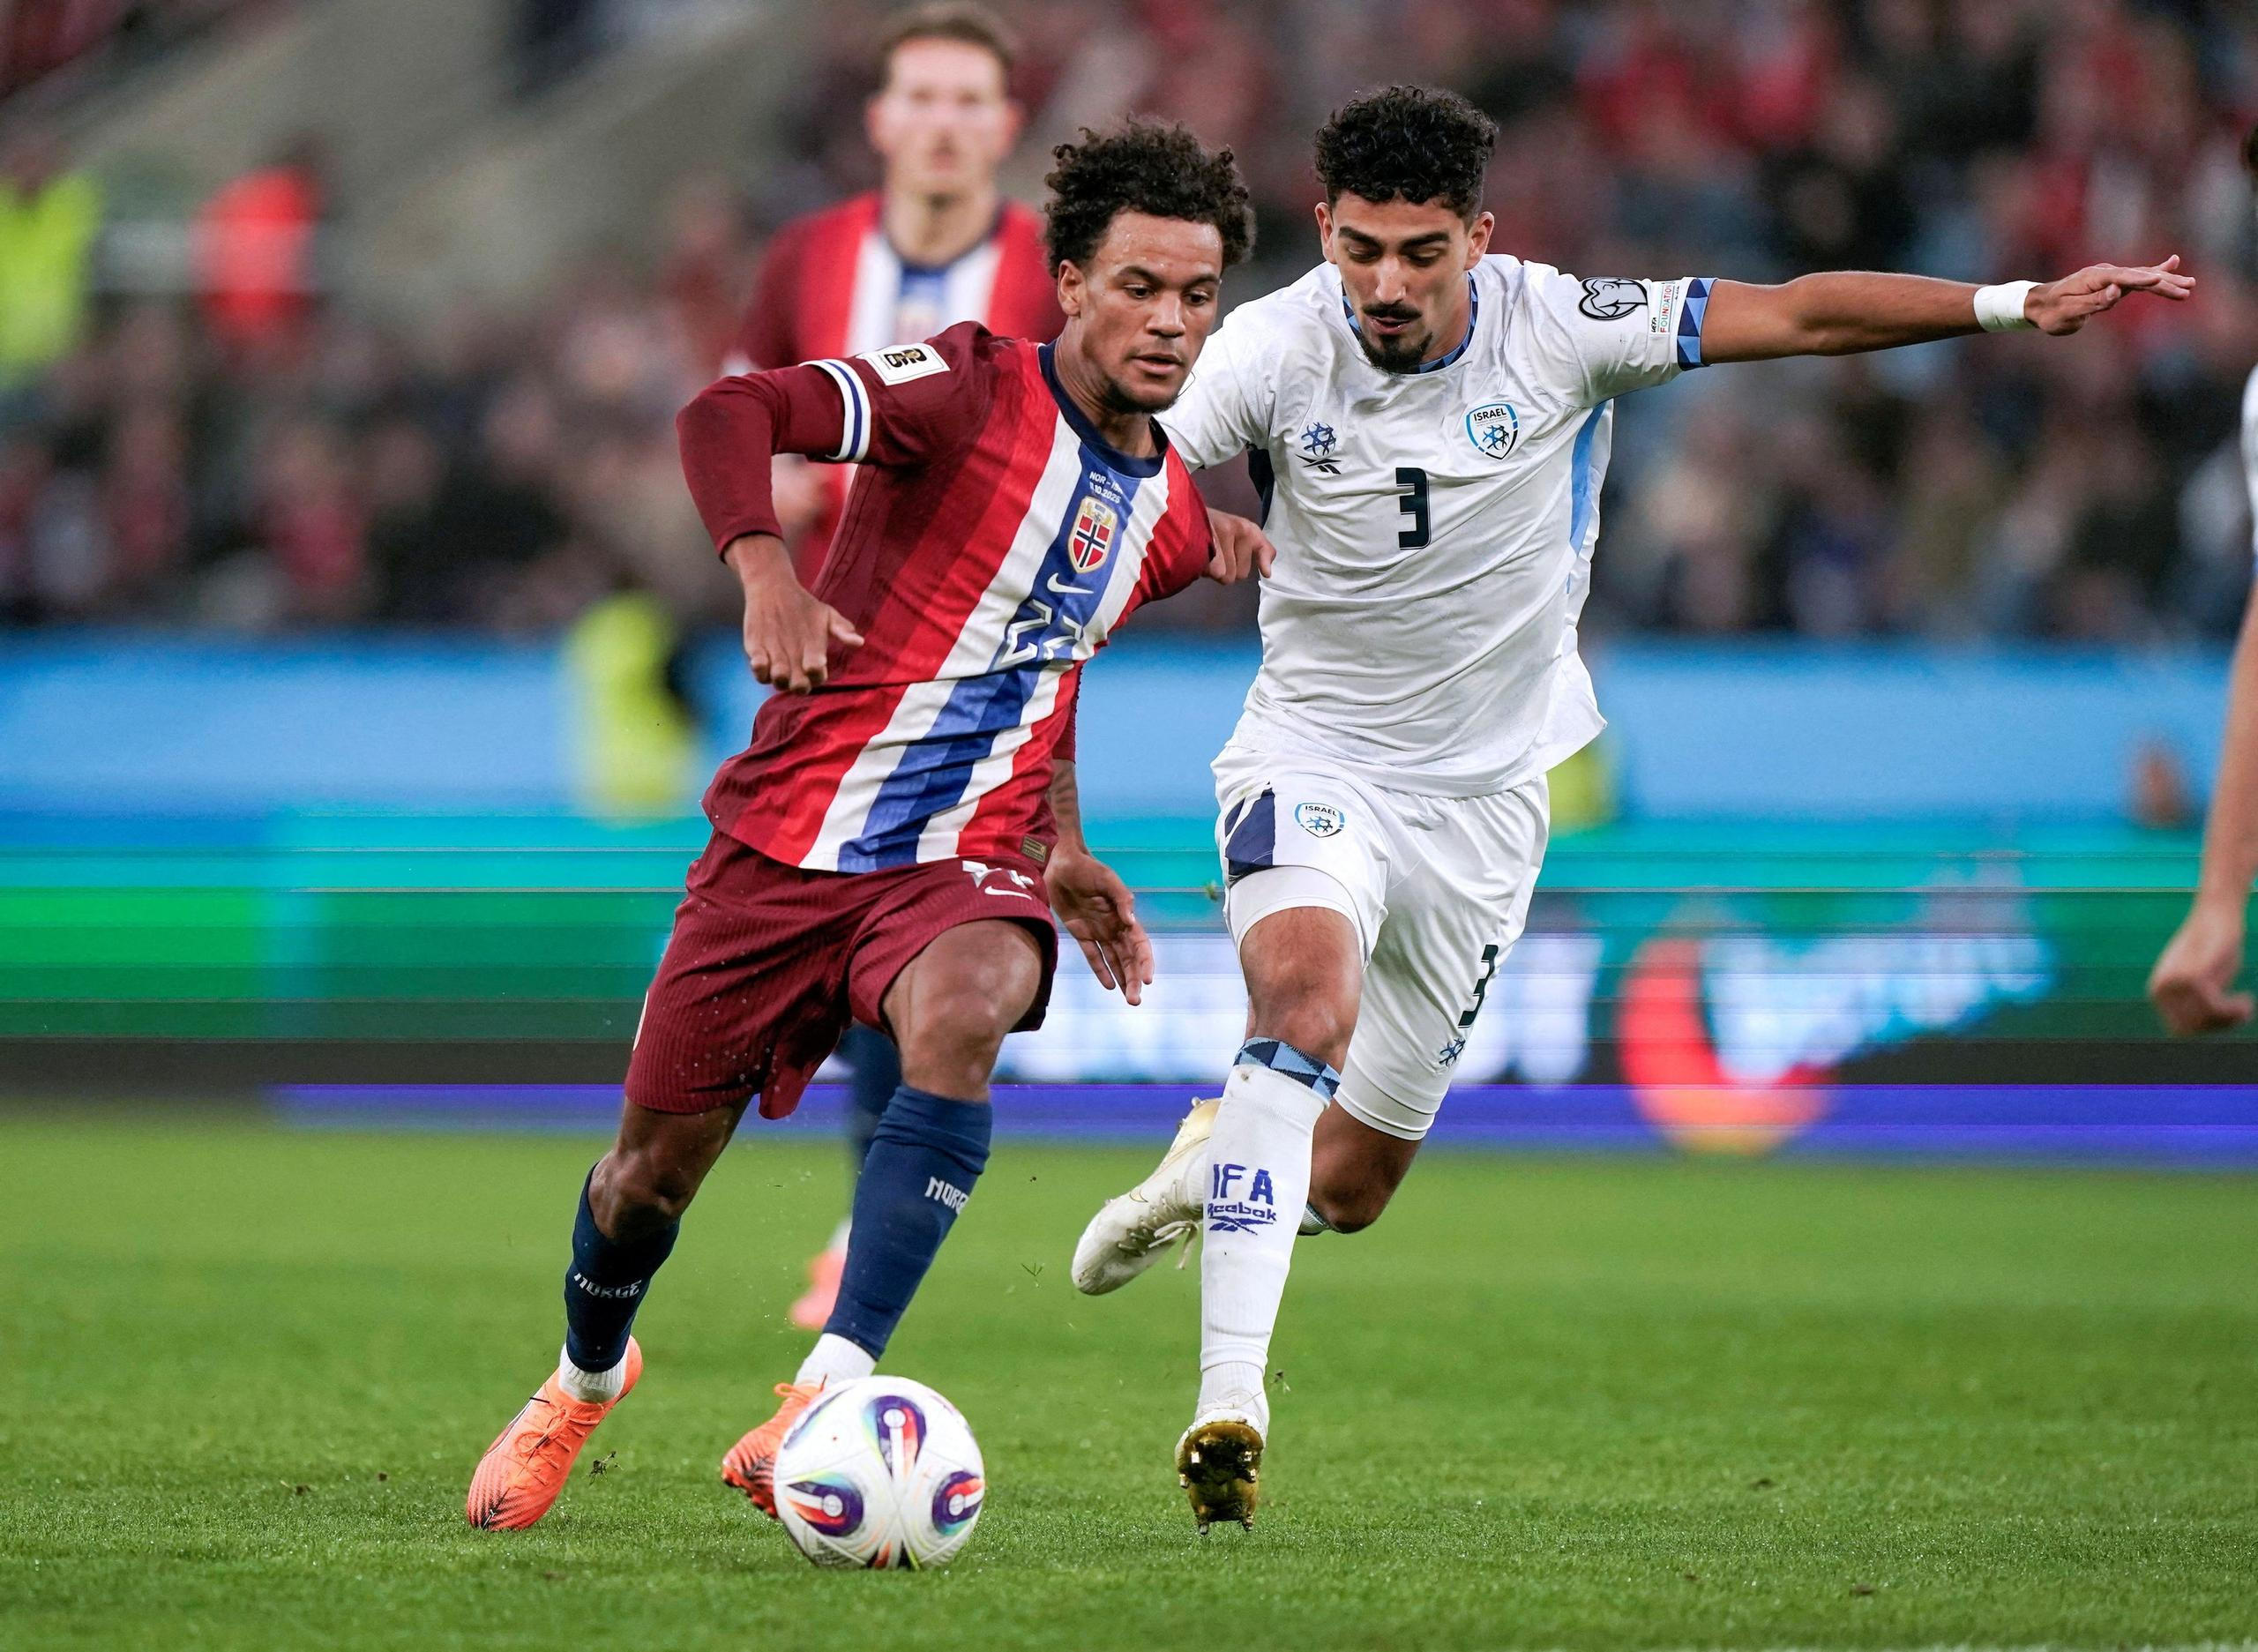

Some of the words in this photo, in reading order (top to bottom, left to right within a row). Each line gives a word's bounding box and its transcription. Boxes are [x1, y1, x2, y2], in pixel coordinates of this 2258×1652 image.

[1659, 284, 1673, 333] FOUNDATION
[1473, 407, 1507, 422] ISRAEL
[1089, 471, 1106, 484] NOR
[1395, 467, 1431, 550] 3
[1305, 805, 1337, 817] ISRAEL
[1458, 944, 1499, 1028] 3
[1212, 1163, 1274, 1206] IFA
[1207, 1201, 1277, 1222] Reebok
